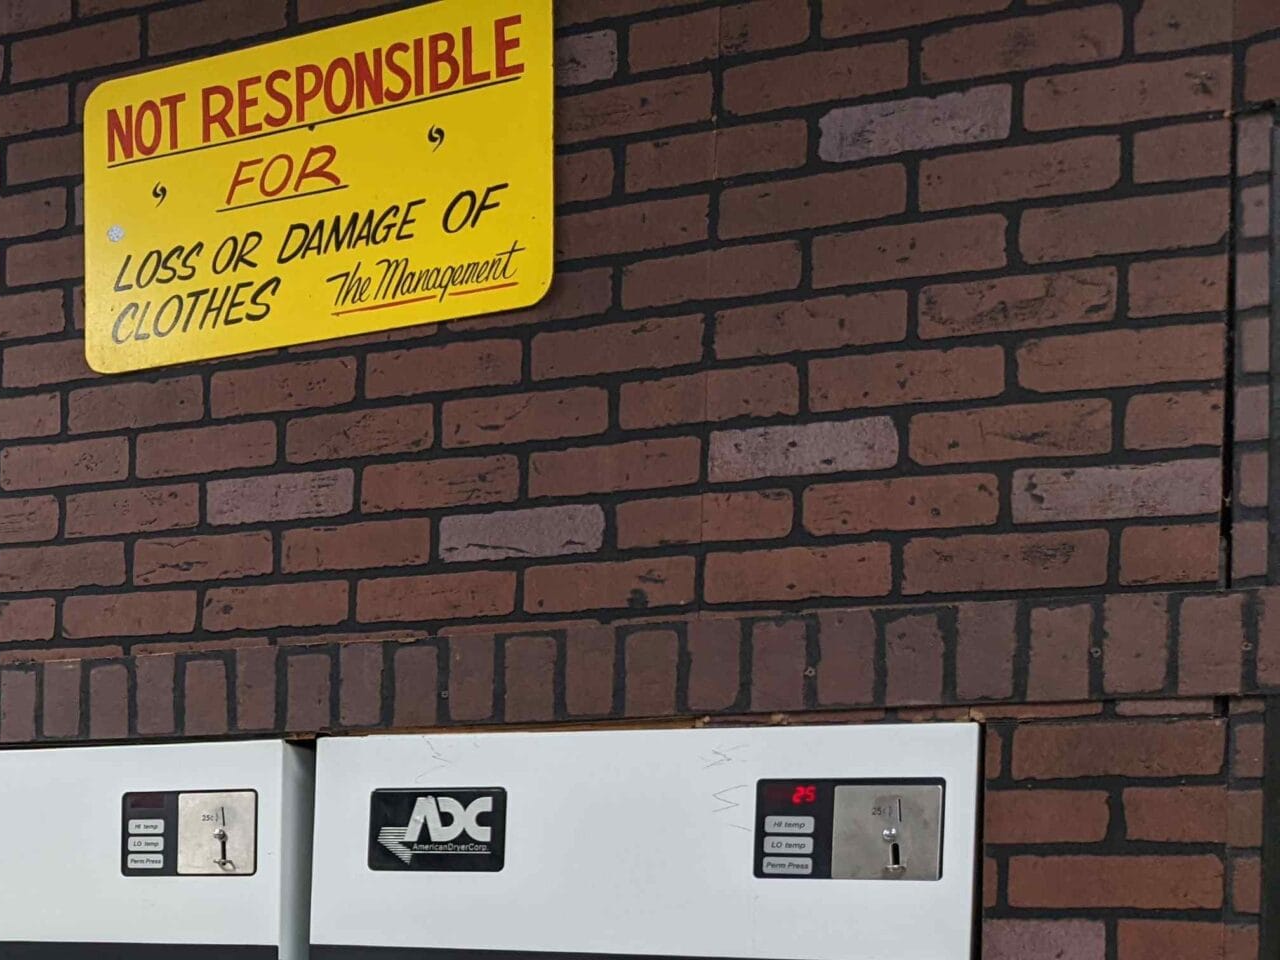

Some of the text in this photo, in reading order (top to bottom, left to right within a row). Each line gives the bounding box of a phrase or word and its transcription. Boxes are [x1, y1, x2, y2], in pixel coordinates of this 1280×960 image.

[107, 15, 525, 163] NOT RESPONSIBLE
[226, 145, 342, 205] FOR
[114, 183, 509, 292] LOSS OR DAMAGE OF
[326, 240, 526, 307] The Management
[111, 277, 281, 344] CLOTHES
[403, 796, 493, 842] ADC
[792, 786, 816, 804] 25
[784, 821, 806, 829] temp
[784, 842, 807, 850] temp
[766, 861, 809, 870] Perm Press
